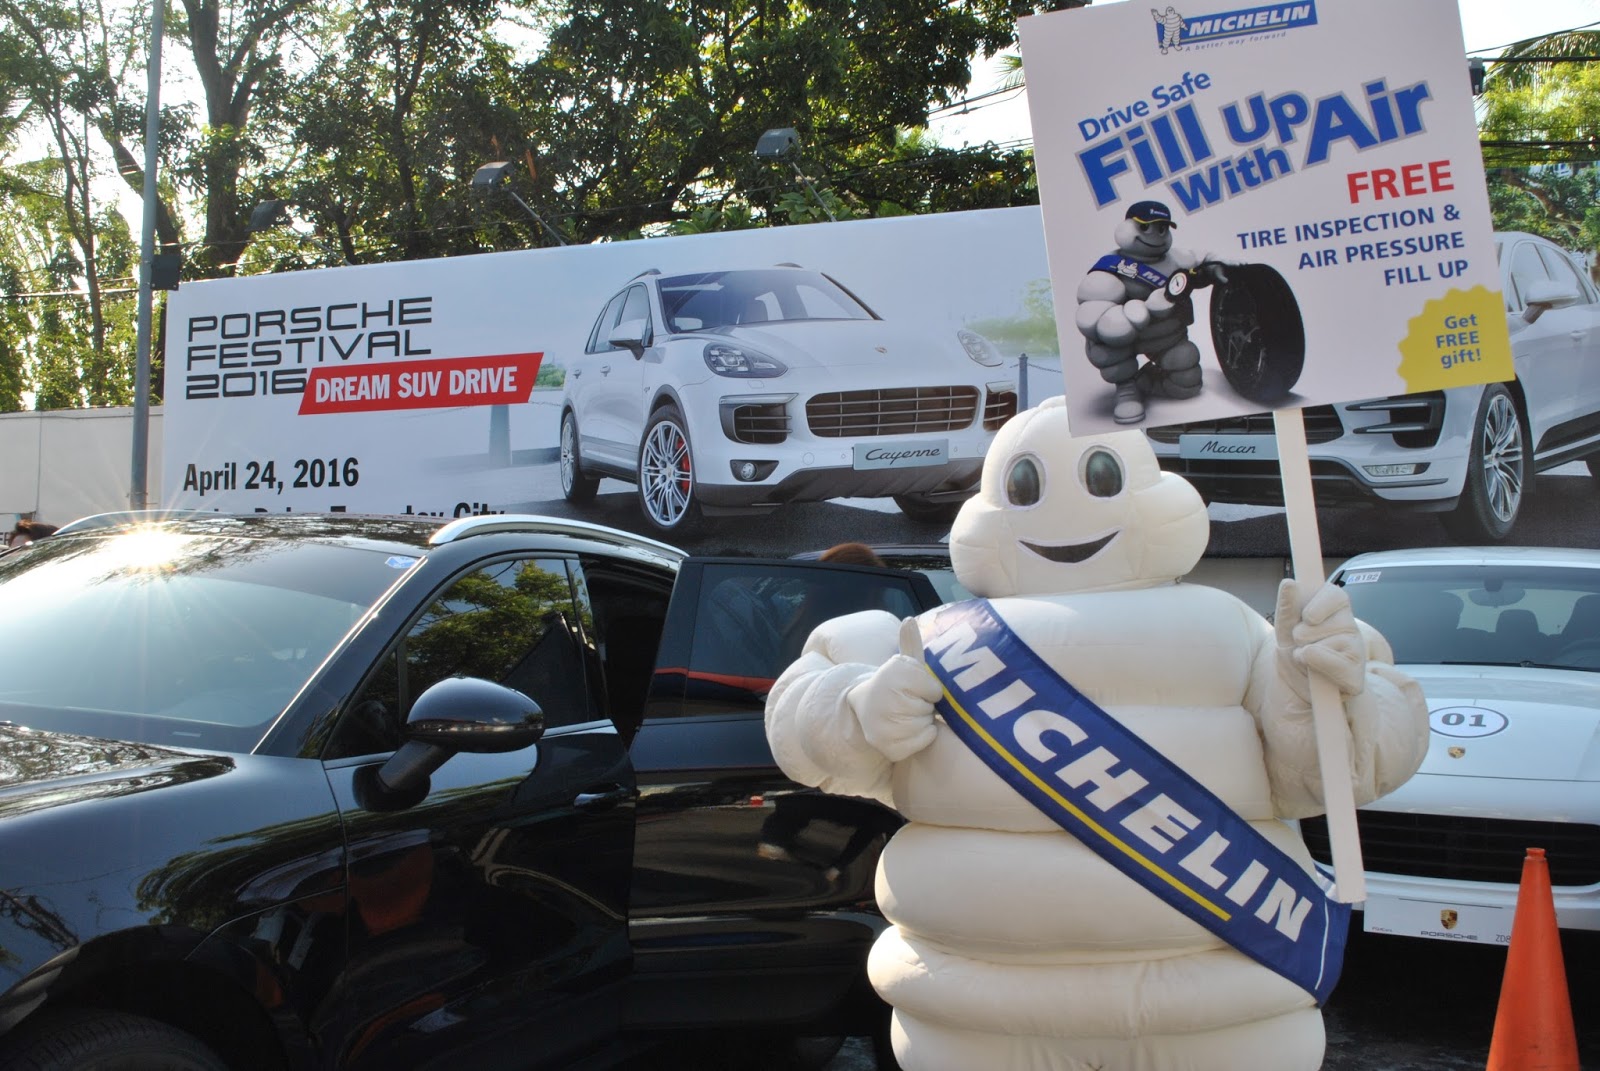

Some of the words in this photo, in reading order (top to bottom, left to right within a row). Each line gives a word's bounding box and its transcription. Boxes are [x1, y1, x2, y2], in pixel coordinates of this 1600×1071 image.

[1188, 4, 1311, 37] MICHELIN
[1195, 41, 1224, 51] better
[1228, 38, 1246, 47] way
[1250, 31, 1287, 43] forward
[1078, 99, 1149, 141] Drive
[1151, 70, 1211, 110] Safe
[1077, 102, 1211, 208] Fill
[1167, 145, 1290, 213] With
[1305, 77, 1430, 167] Air
[1347, 160, 1454, 204] FREE
[1237, 227, 1286, 250] TIRE
[1295, 207, 1435, 242] INSPECTION
[1443, 203, 1461, 221] &
[1298, 249, 1338, 270] AIR
[1345, 231, 1466, 264] PRESSURE
[1384, 265, 1432, 287] FILL
[1438, 260, 1470, 279] UP
[188, 296, 433, 342] PORSCHE
[1443, 313, 1478, 330] Get
[186, 329, 432, 372] FESTIVAL
[1435, 331, 1480, 349] FREE
[1440, 348, 1482, 370] gift!
[185, 367, 307, 400] 2016
[315, 374, 390, 403] DREAM
[397, 371, 442, 397] SUV
[449, 366, 518, 395] DRIVE
[865, 446, 942, 467] Cayenne
[1200, 440, 1257, 455] Macan
[183, 461, 237, 497] April
[245, 460, 283, 494] 24,
[293, 456, 360, 489] 2016
[1440, 712, 1487, 728] 01
[924, 624, 1313, 943] MICHELIN
[1420, 930, 1478, 941] PORSCHE
